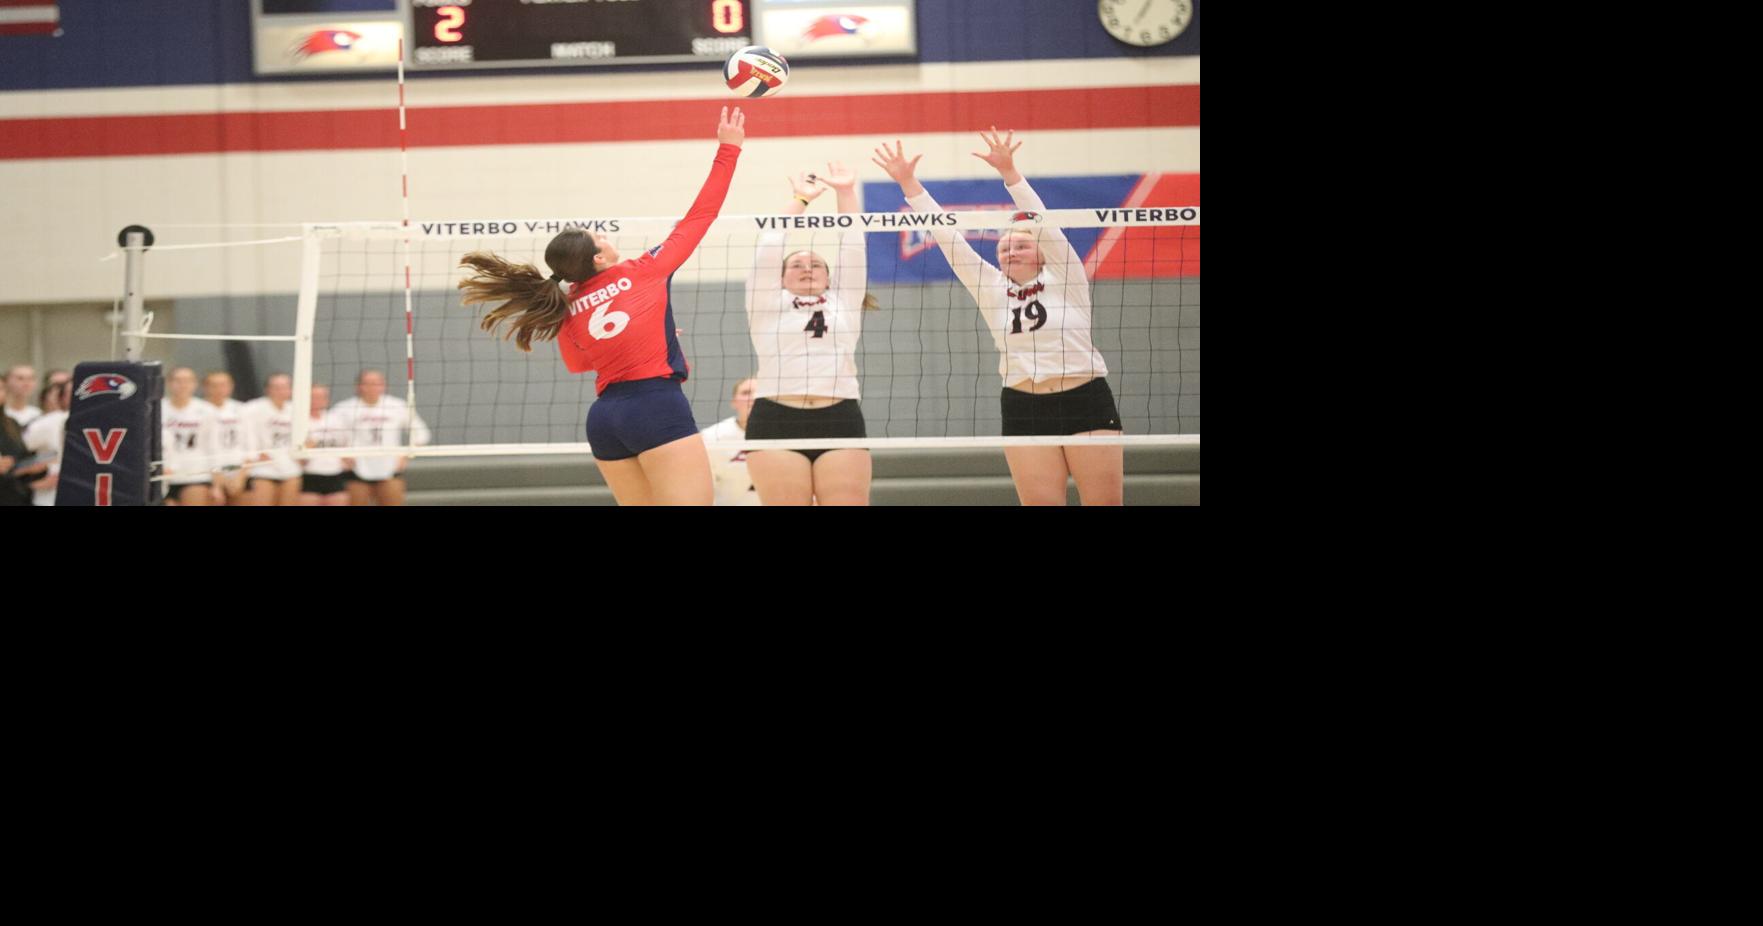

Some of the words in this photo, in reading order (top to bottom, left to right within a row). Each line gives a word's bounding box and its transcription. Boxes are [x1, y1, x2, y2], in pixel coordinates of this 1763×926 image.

[434, 5, 466, 42] 2
[711, 0, 744, 33] 0
[421, 222, 518, 236] VITERBO
[755, 215, 853, 229] VITERBO
[860, 212, 958, 227] V-HAWKS
[1095, 208, 1197, 222] VITERBO
[568, 277, 632, 317] VITERBO
[588, 299, 631, 341] 6
[803, 310, 829, 338] 4
[1010, 300, 1048, 335] 19
